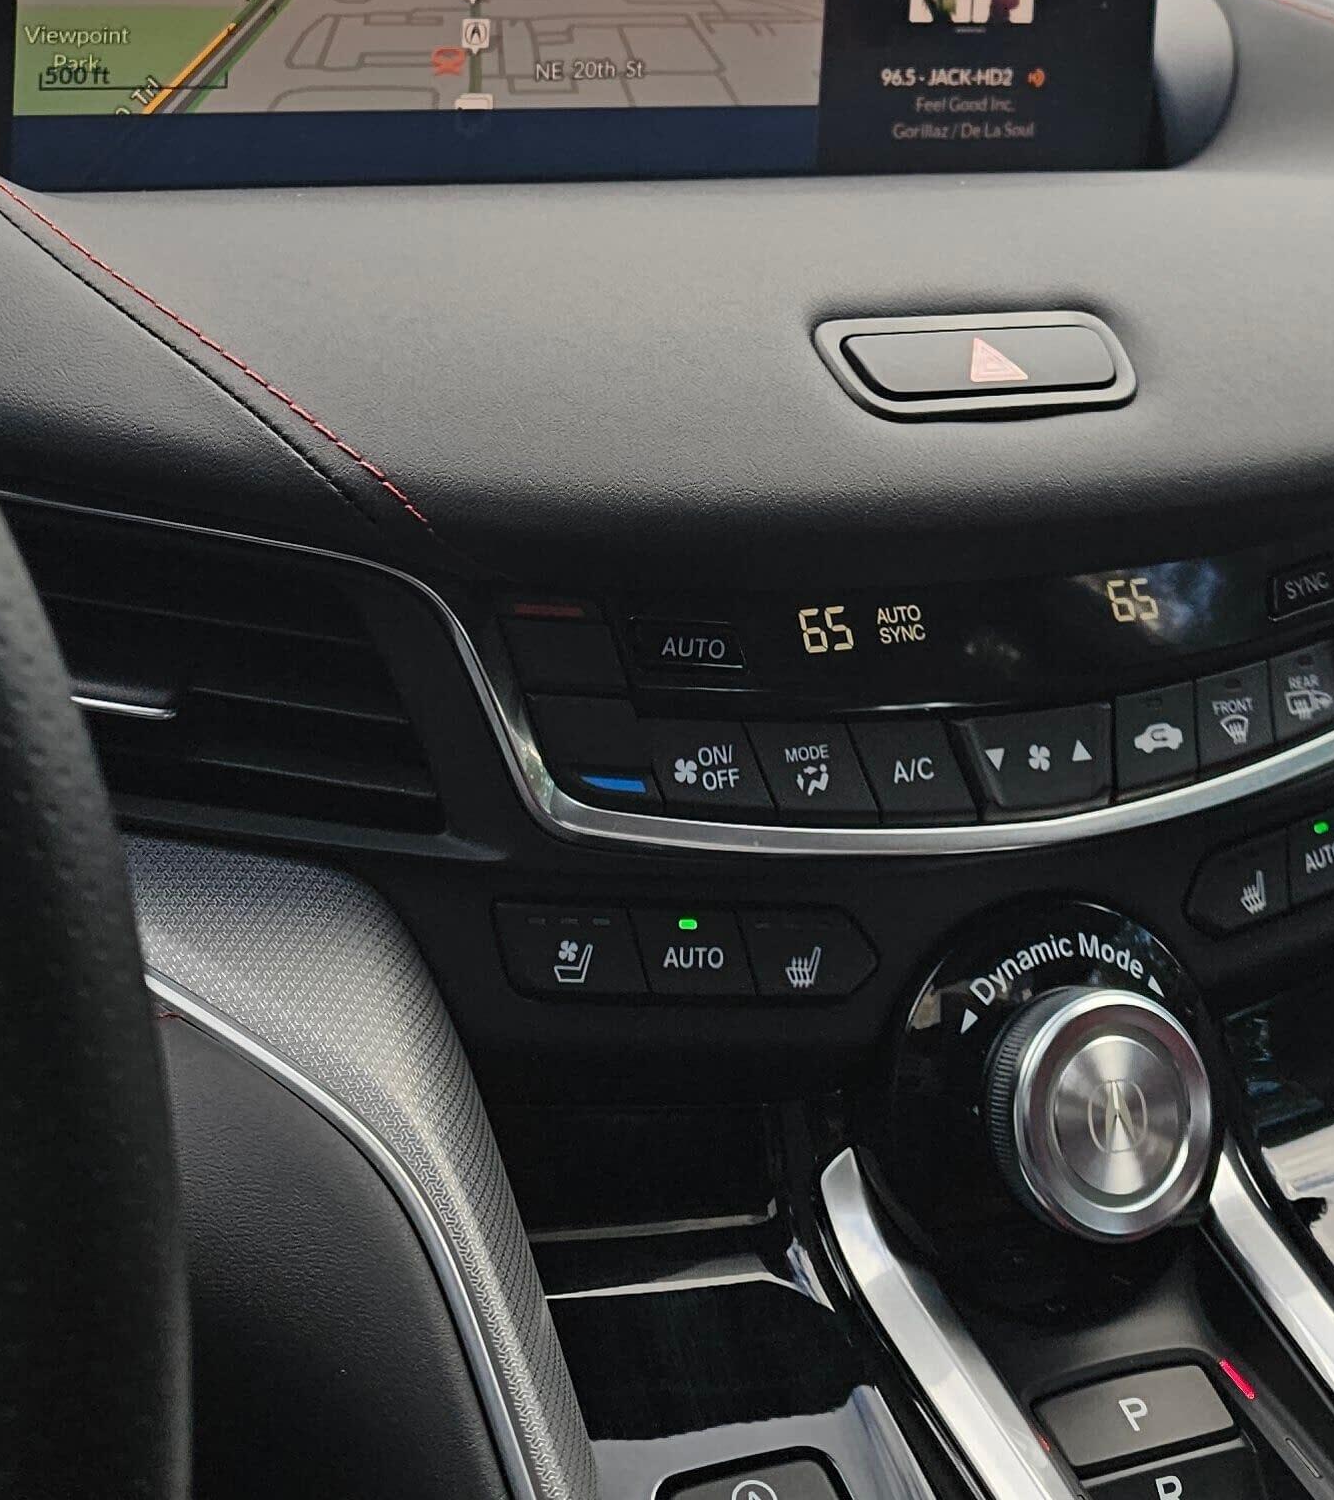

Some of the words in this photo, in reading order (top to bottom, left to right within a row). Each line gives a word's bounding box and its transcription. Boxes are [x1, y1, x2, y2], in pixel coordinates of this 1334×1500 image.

[24, 25, 130, 47] Viewpoint
[53, 53, 101, 73] Park
[536, 62, 563, 81] NE
[573, 60, 615, 79] 20th
[626, 60, 642, 78] St
[45, 67, 87, 85] 500
[92, 67, 111, 85] ft
[881, 68, 916, 86] 96.5
[927, 68, 1013, 86] JACK-HD2
[916, 98, 946, 112] Feel
[949, 98, 987, 112] Good
[892, 122, 948, 139] Gorillaz
[961, 122, 981, 138] De
[984, 123, 1002, 138] La
[1004, 122, 1035, 138] Soul
[1284, 571, 1330, 600] SYNC
[1107, 578, 1159, 622] 65
[876, 604, 922, 625] AUTO
[798, 605, 854, 653] 65
[879, 623, 926, 645] SYNC
[661, 636, 726, 659] AUTO
[1288, 673, 1319, 690] REAR
[1212, 697, 1254, 715] FRONT
[697, 744, 733, 767] ON/
[785, 744, 830, 763] MODE
[702, 767, 740, 791] OFF
[893, 756, 935, 784] A/C
[663, 946, 724, 969] AUTO
[969, 934, 1073, 1006] Dynamic
[1077, 932, 1144, 979] Mode
[1118, 1397, 1148, 1432] P
